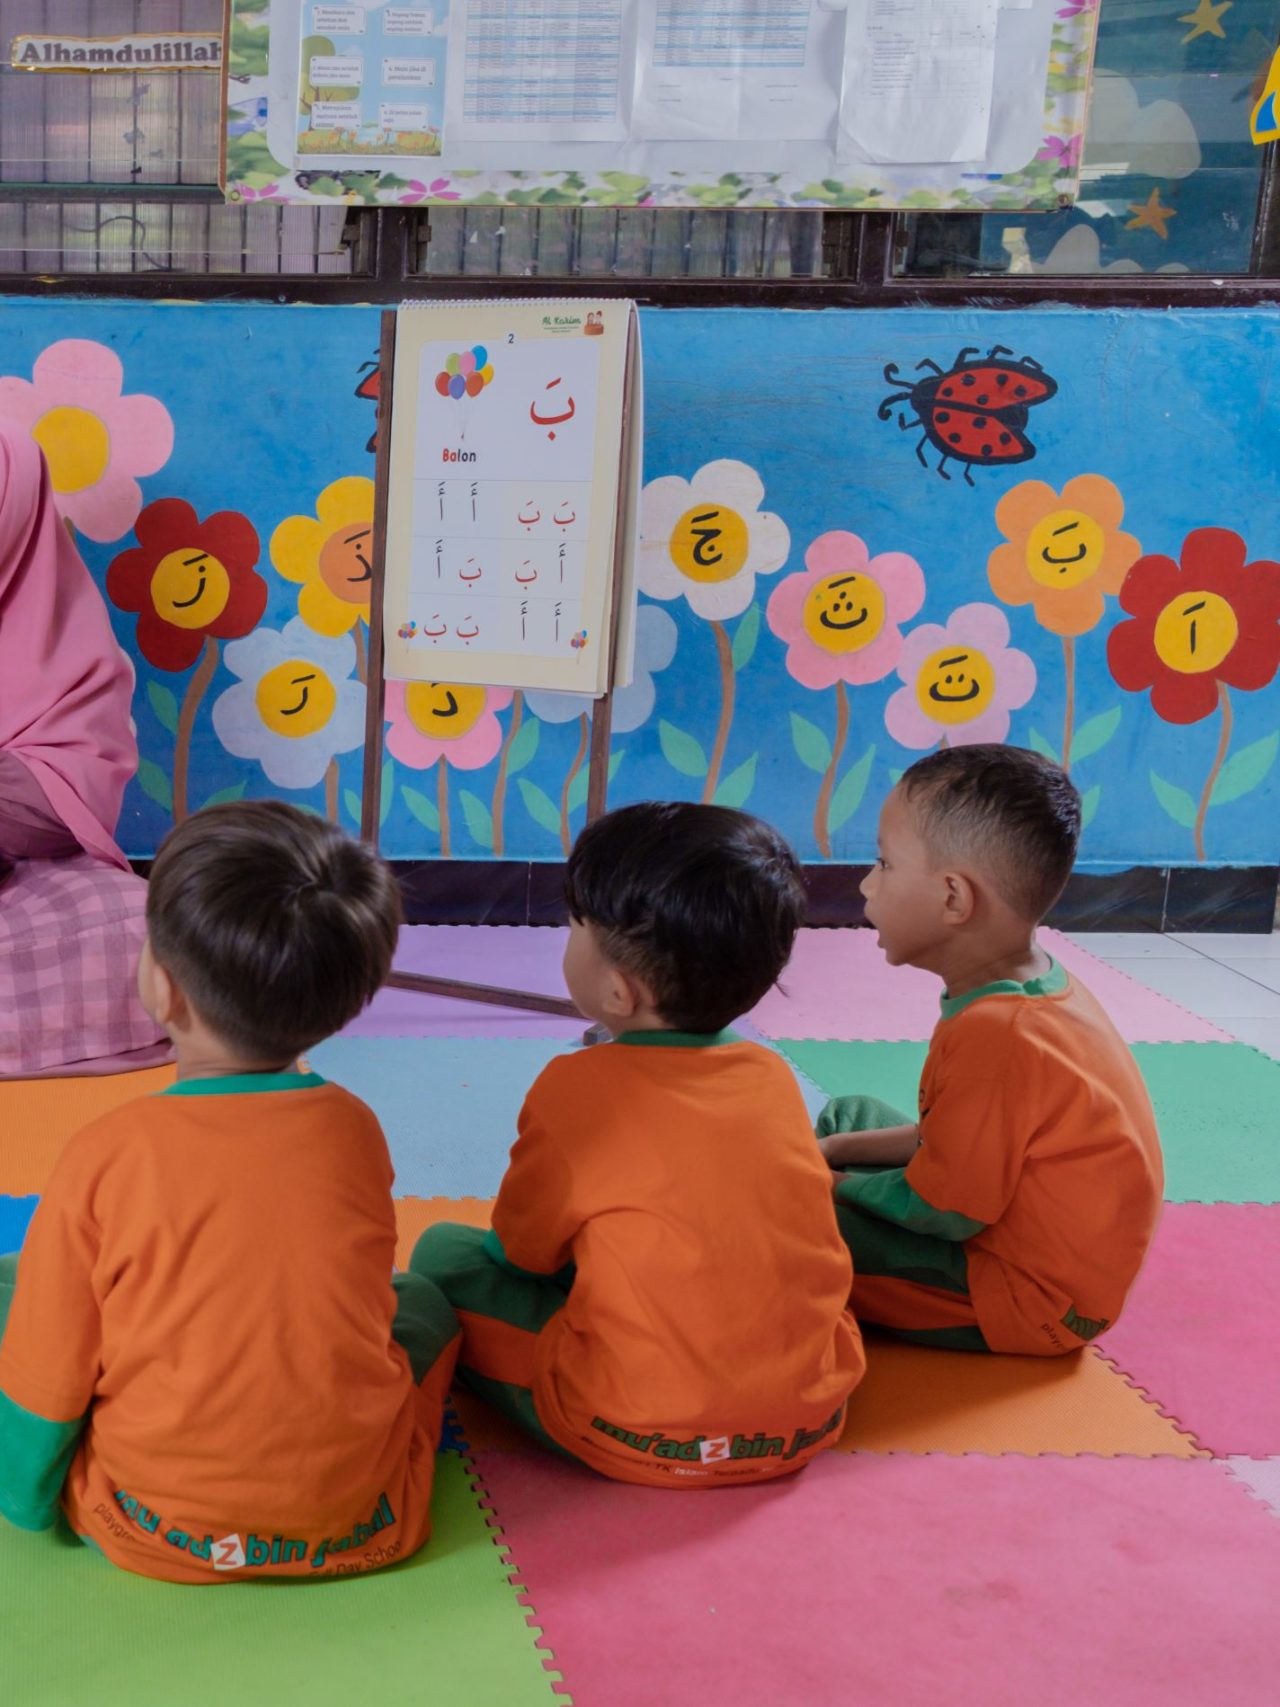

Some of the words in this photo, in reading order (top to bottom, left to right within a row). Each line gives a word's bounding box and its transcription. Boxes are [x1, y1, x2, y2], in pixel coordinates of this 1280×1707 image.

[508, 333, 515, 344] 2
[442, 448, 477, 463] Balon
[729, 1432, 784, 1459] bin
[245, 1534, 309, 1566] bin
